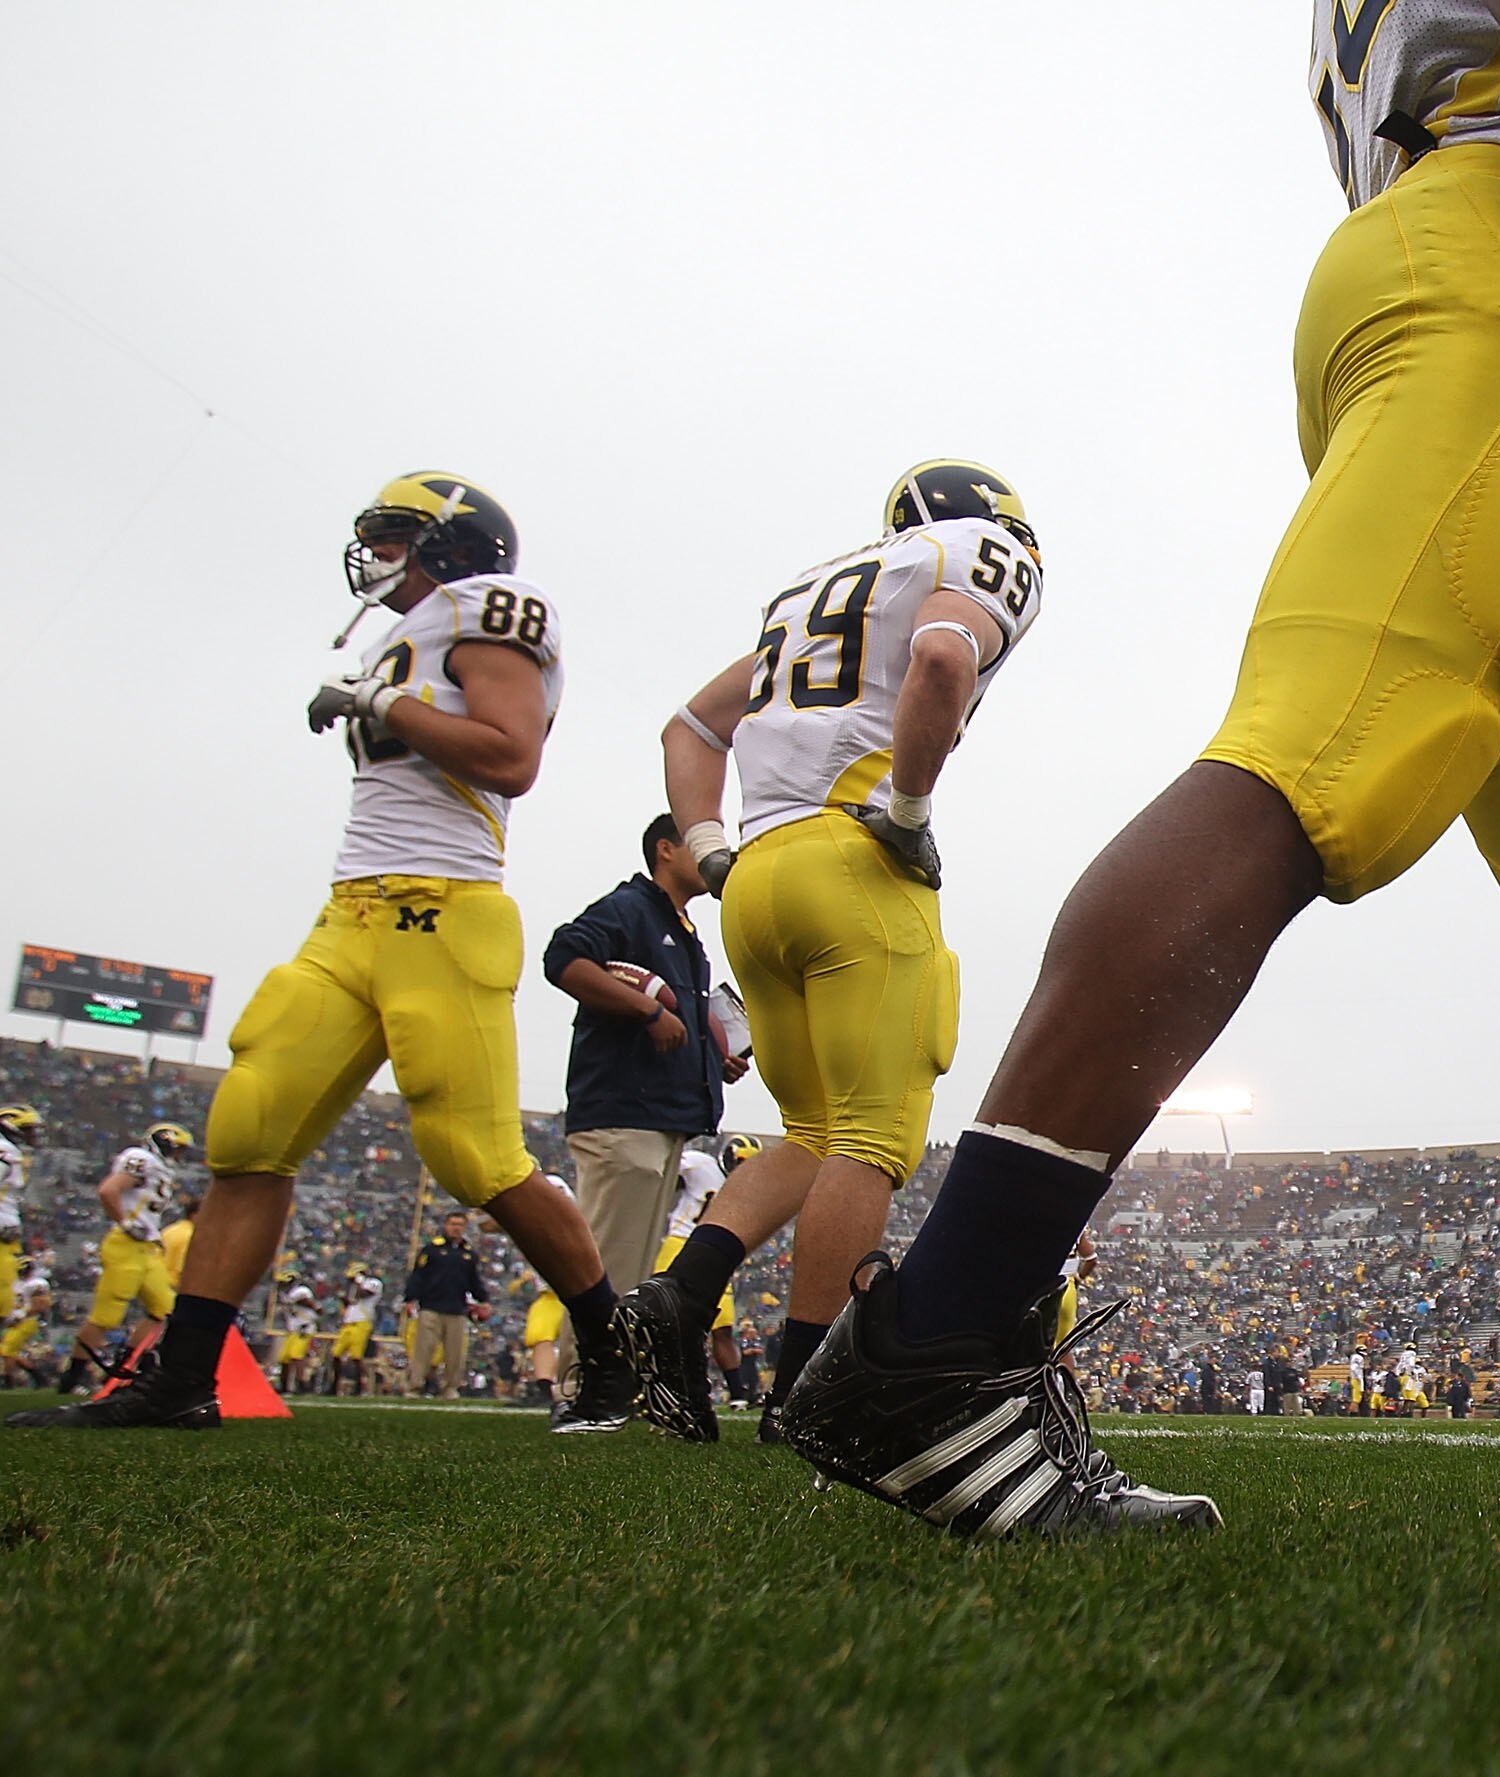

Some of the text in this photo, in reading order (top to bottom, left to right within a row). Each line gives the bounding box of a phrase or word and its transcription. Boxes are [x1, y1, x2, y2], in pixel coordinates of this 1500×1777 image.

[971, 535, 1033, 617] 59
[480, 588, 549, 647] 88
[741, 557, 885, 720] 59
[397, 906, 441, 932] M
